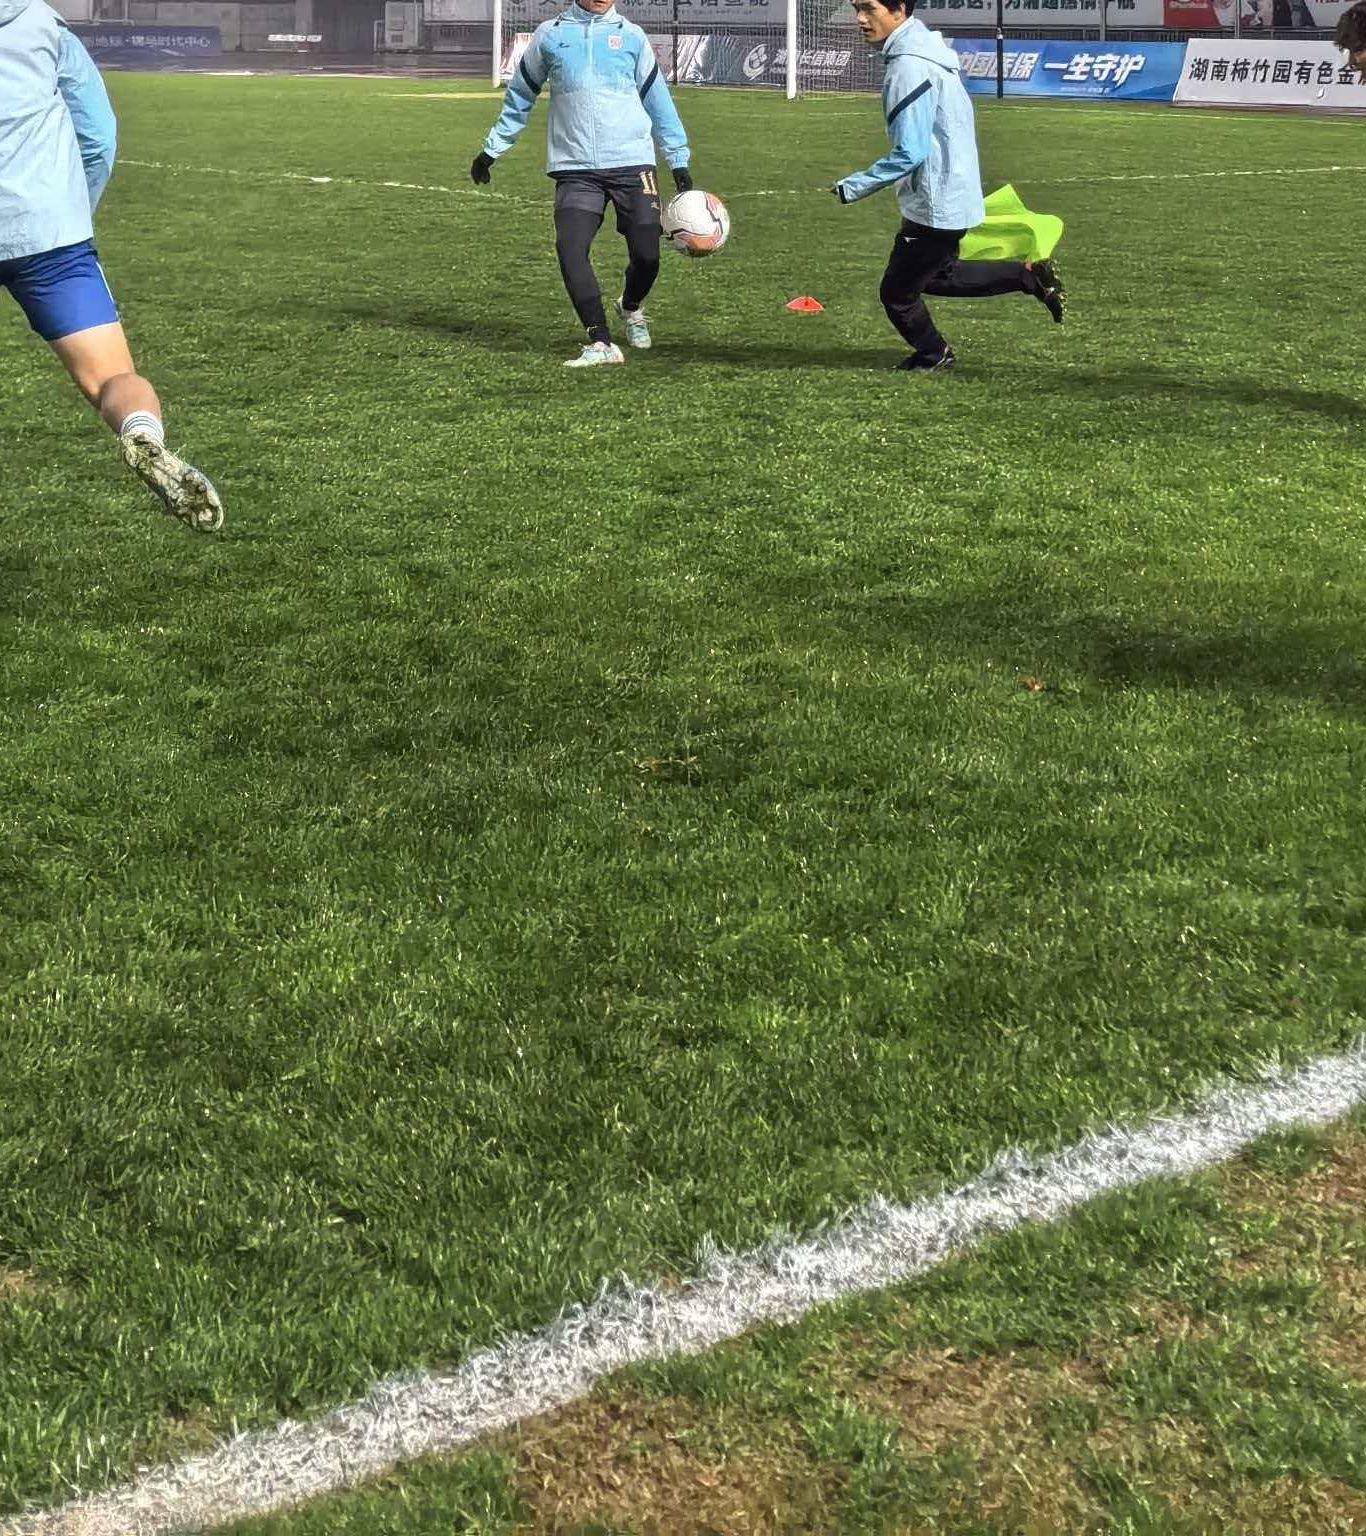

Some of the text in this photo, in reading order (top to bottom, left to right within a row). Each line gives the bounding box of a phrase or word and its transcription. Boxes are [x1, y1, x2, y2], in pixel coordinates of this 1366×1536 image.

[1043, 52, 1147, 88] 一生守护
[1188, 57, 1363, 86] 湖南柿竹园有色金
